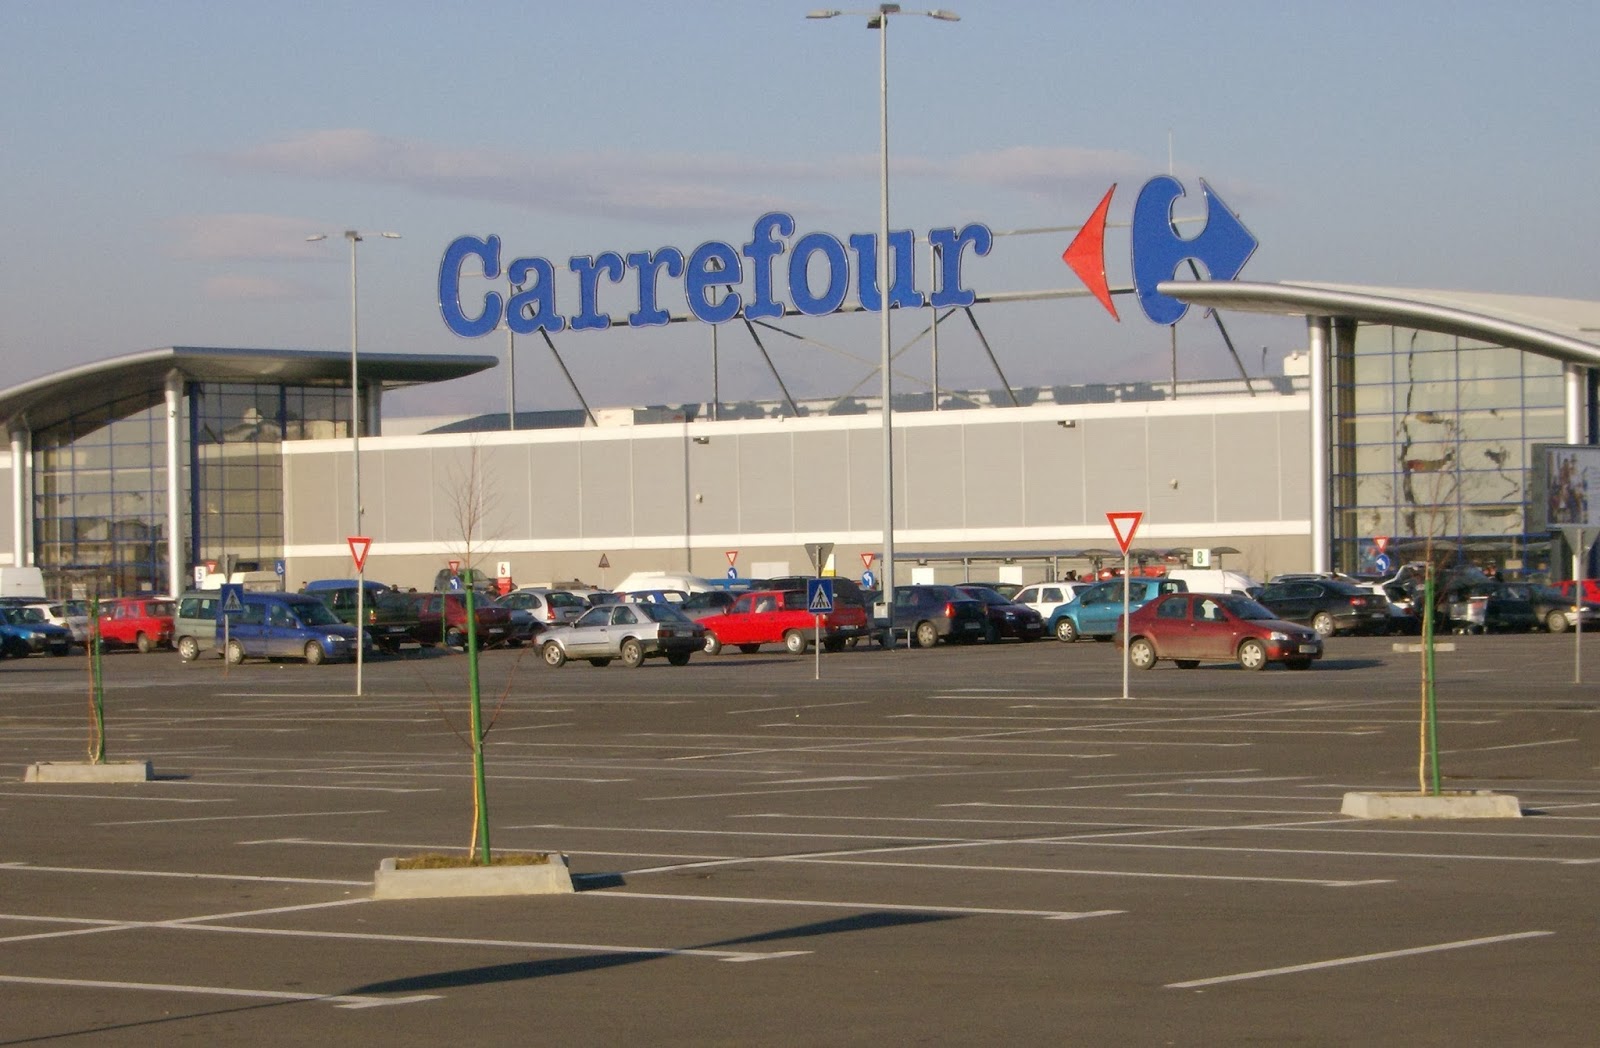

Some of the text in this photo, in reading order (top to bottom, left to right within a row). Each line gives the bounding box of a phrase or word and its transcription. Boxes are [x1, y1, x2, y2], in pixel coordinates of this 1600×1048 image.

[438, 211, 993, 338] Carrefour
[1197, 551, 1204, 564] 8
[500, 563, 506, 575] 6
